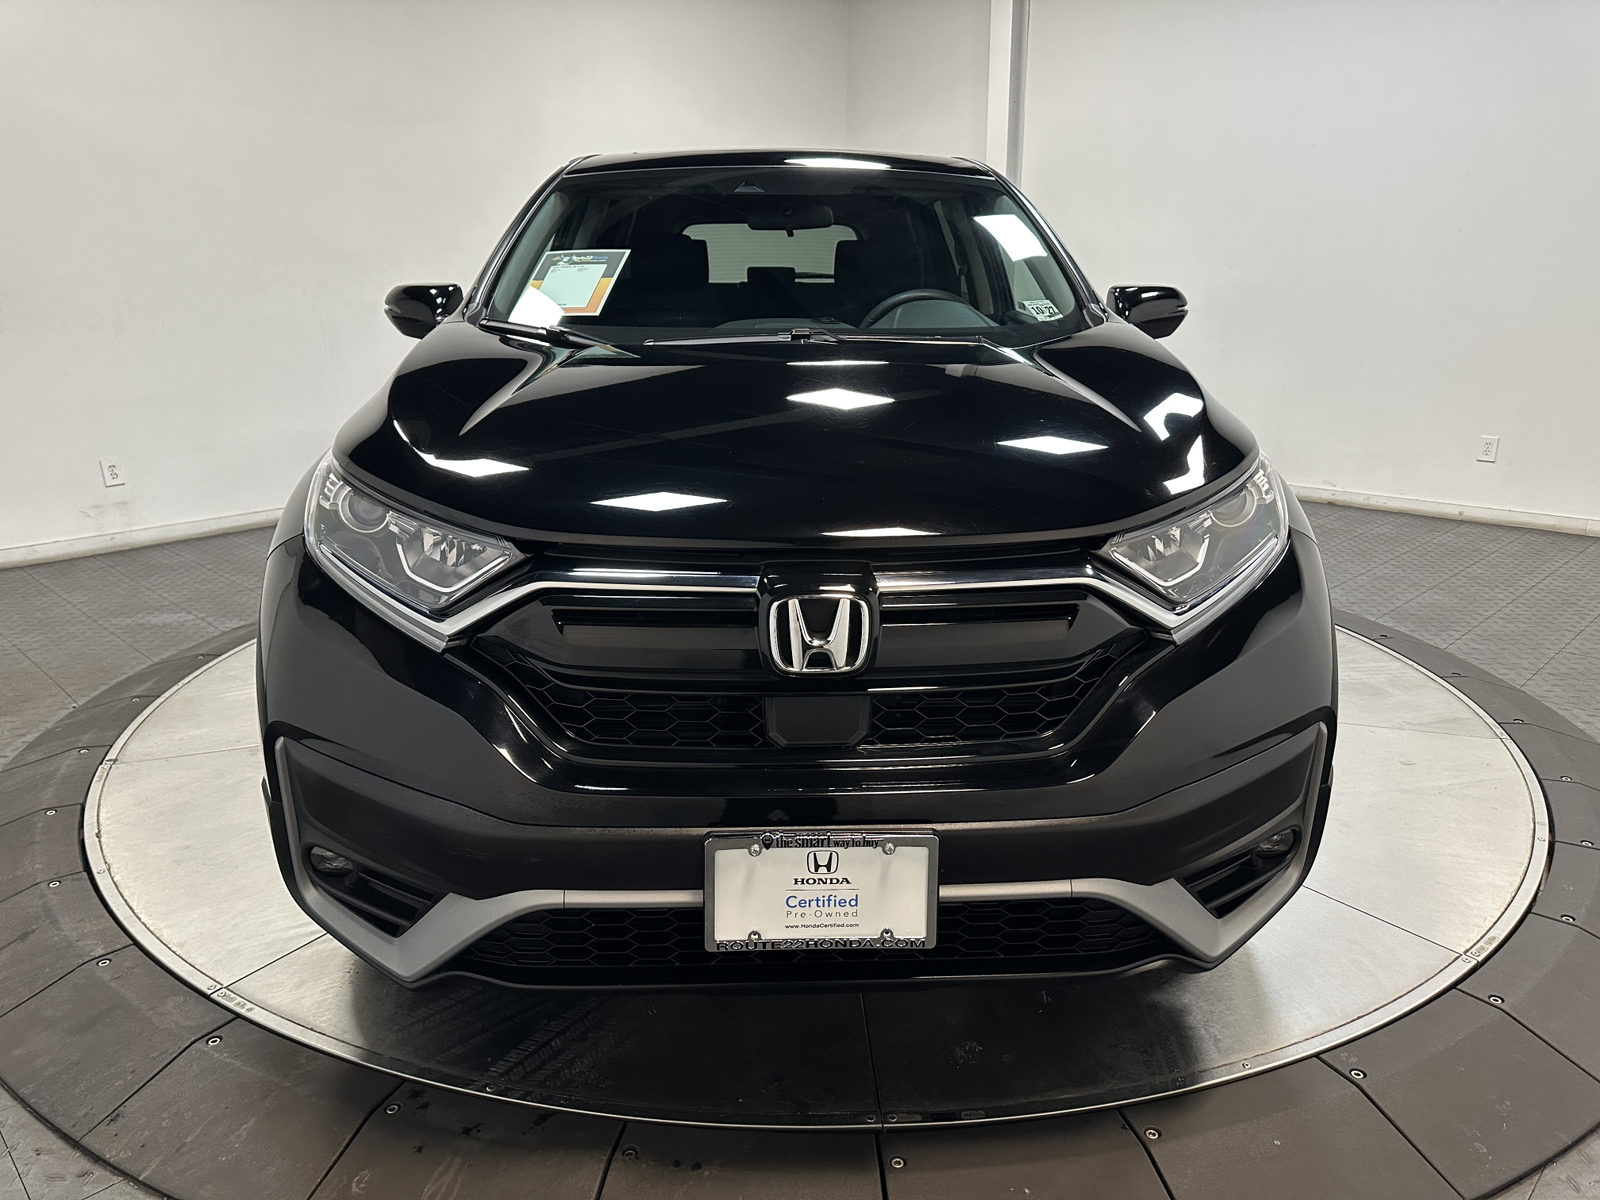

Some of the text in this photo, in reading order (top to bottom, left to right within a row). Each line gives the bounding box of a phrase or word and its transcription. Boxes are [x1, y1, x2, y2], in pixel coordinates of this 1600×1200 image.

[1031, 306, 1044, 315] 10
[776, 833, 879, 849] the smart way to buy
[793, 877, 852, 885] HONDA
[786, 894, 858, 908] Certified
[786, 909, 858, 918] Pre-Owned
[716, 939, 926, 950] ROUTE22HONDA.COM
